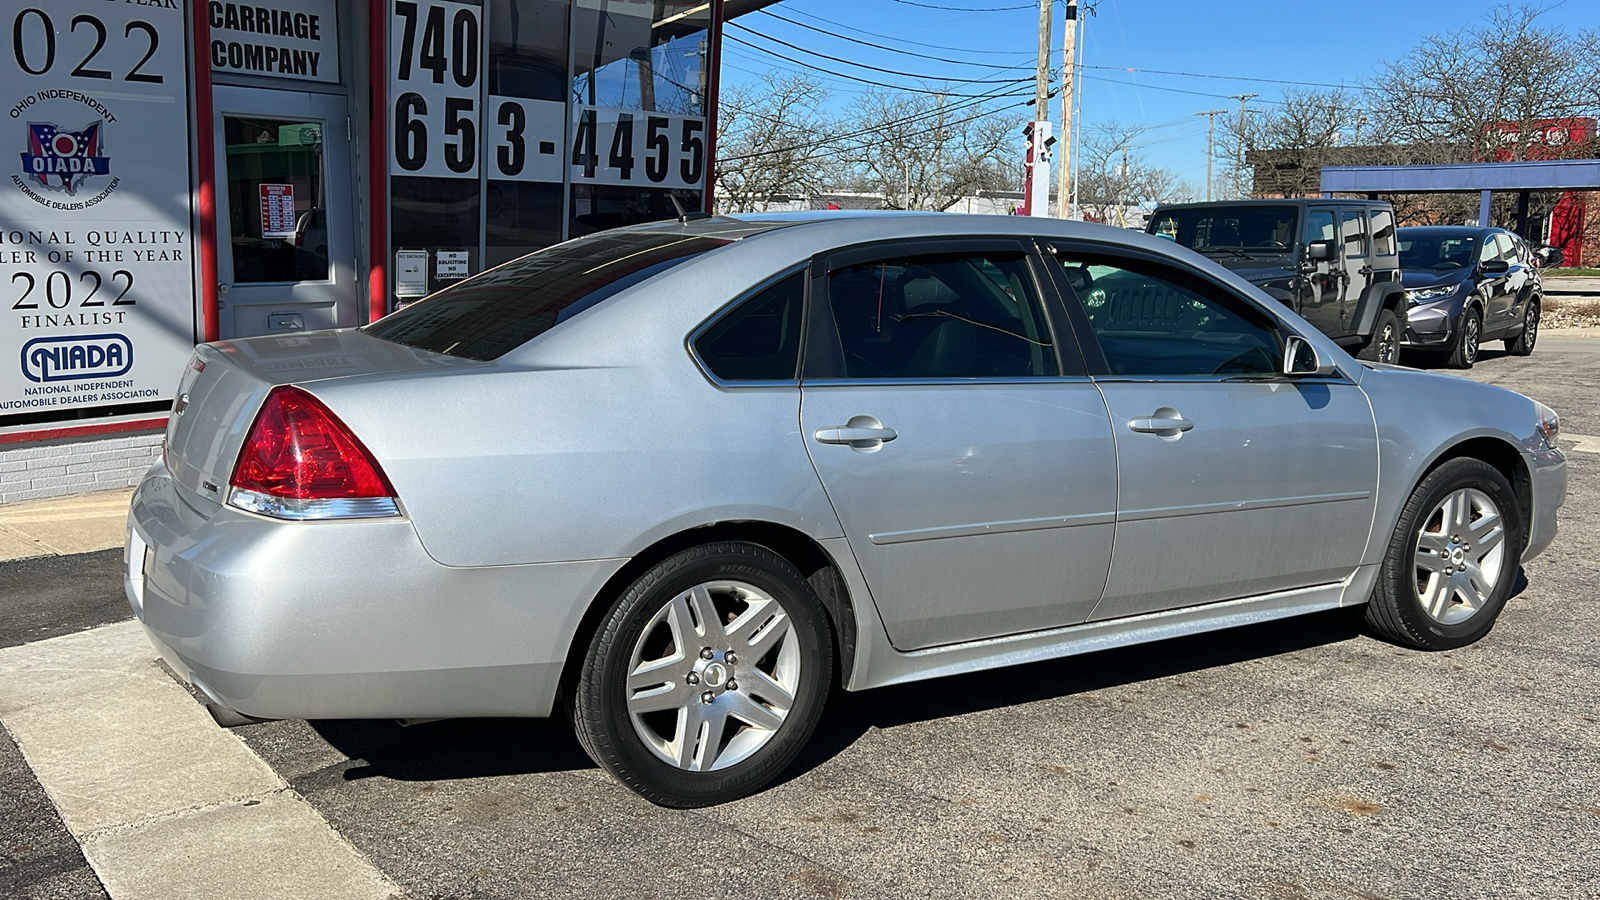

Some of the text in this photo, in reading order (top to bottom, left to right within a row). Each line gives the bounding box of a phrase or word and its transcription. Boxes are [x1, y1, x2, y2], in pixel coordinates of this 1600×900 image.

[209, 1, 321, 41] CARRIAGE
[211, 40, 320, 77] COMPANY
[395, 2, 478, 88] 740
[9, 89, 117, 123] OHIO INDEPENDENT
[32, 157, 96, 173] OIADA
[10, 174, 121, 211] AUTOMOBILE DEALERS ASSOCIATION
[0, 231, 185, 246] IONAL QUALITY
[0, 249, 183, 264] LER OF THE YEAR
[11, 270, 136, 310] 2022
[21, 312, 126, 329] FINALIST
[30, 342, 123, 380] NIADA
[24, 380, 134, 396] NATIONAL INDEPENDENT
[60, 394, 98, 404] DEALERS
[100, 389, 159, 401] ASSOCIATION
